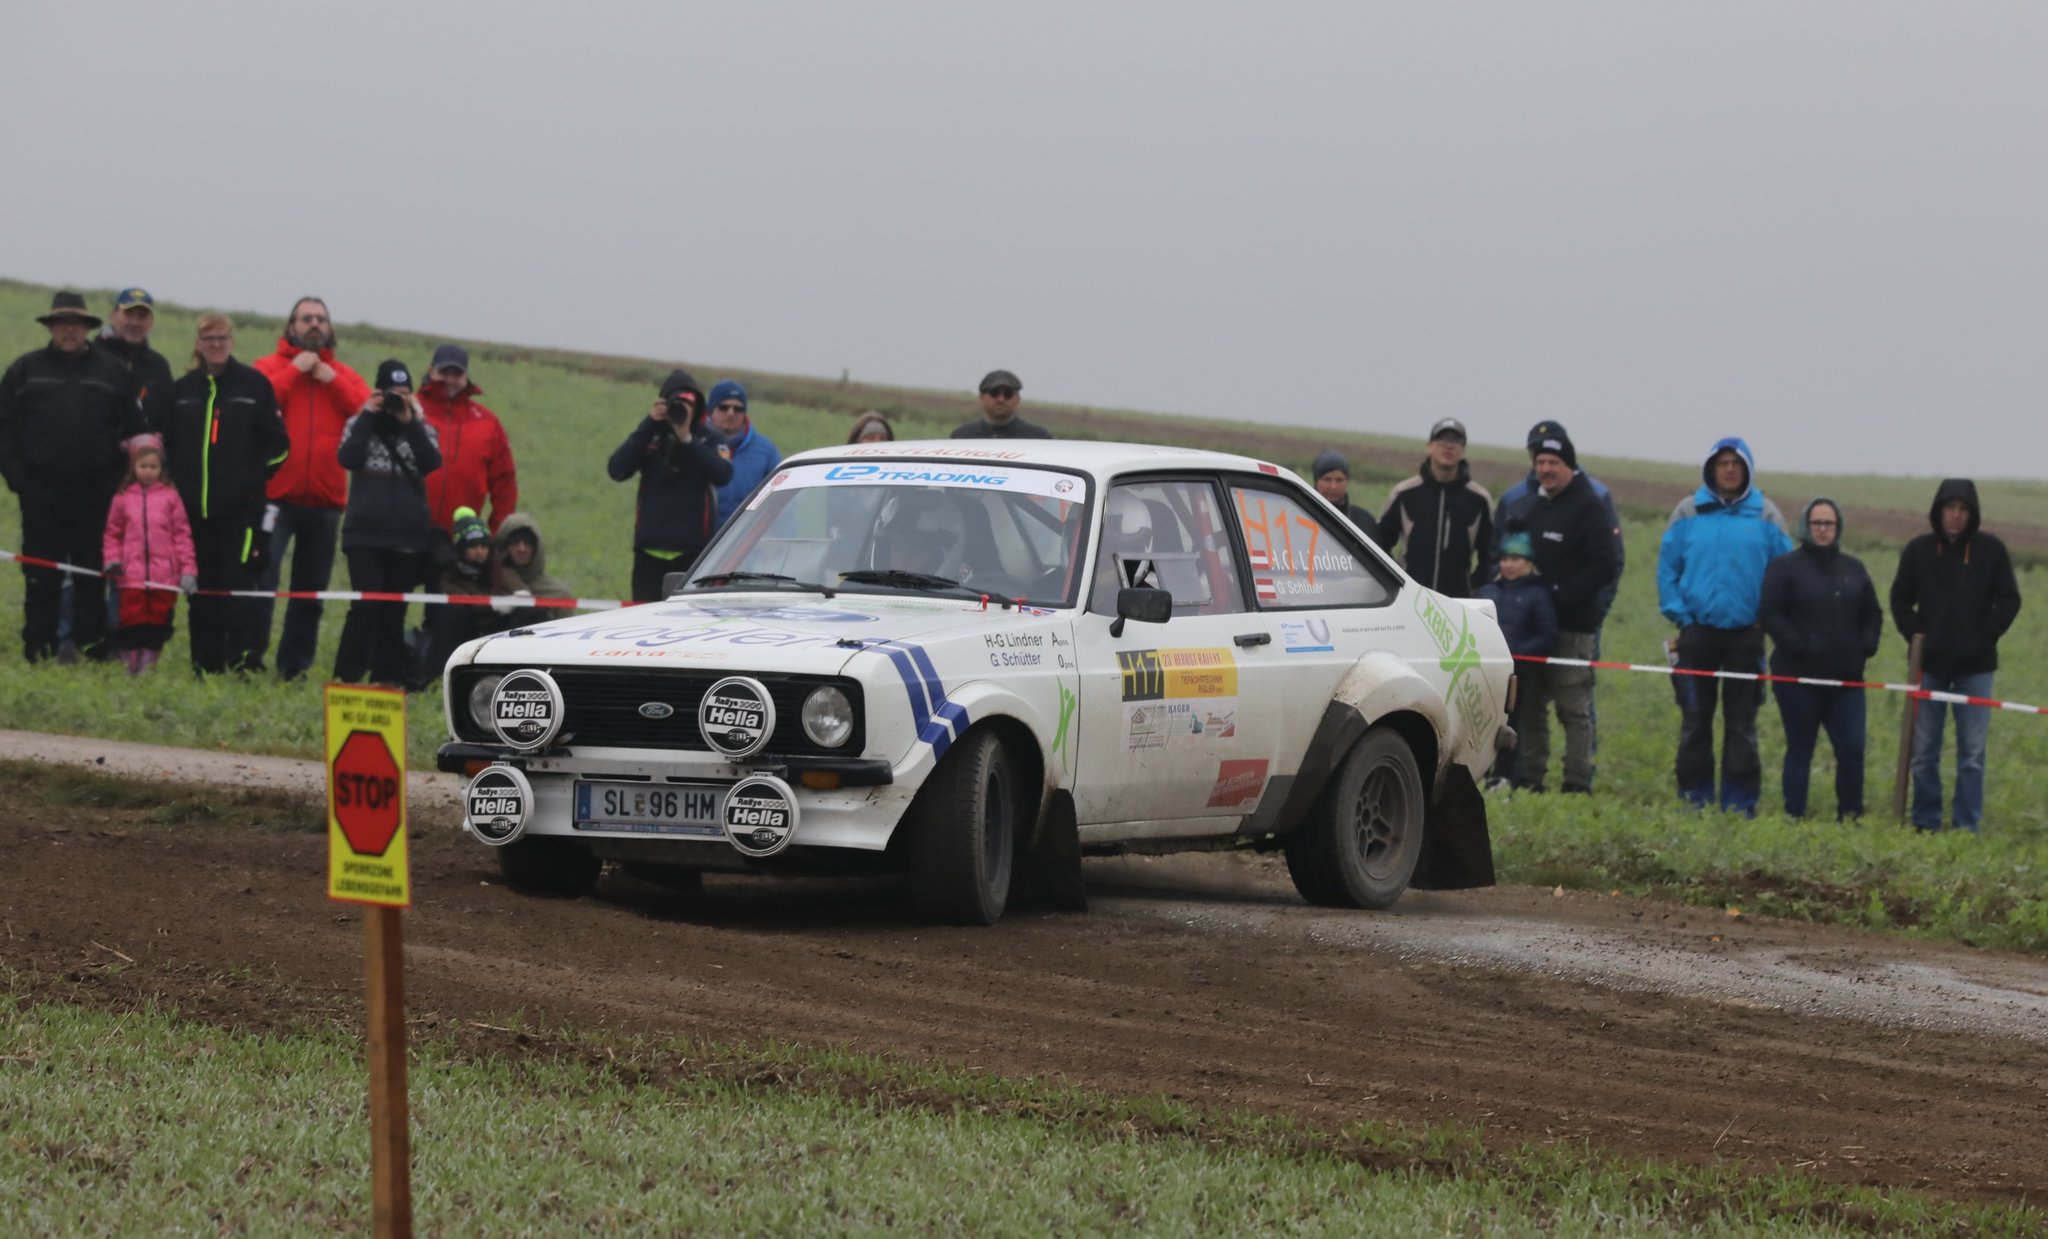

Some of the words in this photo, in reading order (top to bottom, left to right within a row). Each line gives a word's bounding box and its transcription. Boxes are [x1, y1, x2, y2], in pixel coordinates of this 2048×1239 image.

[878, 471, 1009, 486] TRADING
[1299, 550, 1353, 571] Lndner
[1005, 632, 1043, 648] Lindner
[1002, 652, 1041, 667] Schütter
[504, 691, 526, 700] Rallye
[714, 696, 738, 708] Rallye
[500, 702, 547, 718] Hella
[709, 707, 759, 727] Hella
[1168, 704, 1191, 714] HAGER
[336, 772, 397, 811] STOP
[477, 788, 498, 797] Rallye
[474, 798, 517, 814] Hella
[604, 789, 630, 816] SL
[650, 791, 678, 818] 96
[684, 793, 715, 820] HM
[737, 798, 762, 807] Rallye
[732, 808, 784, 826] Hella
